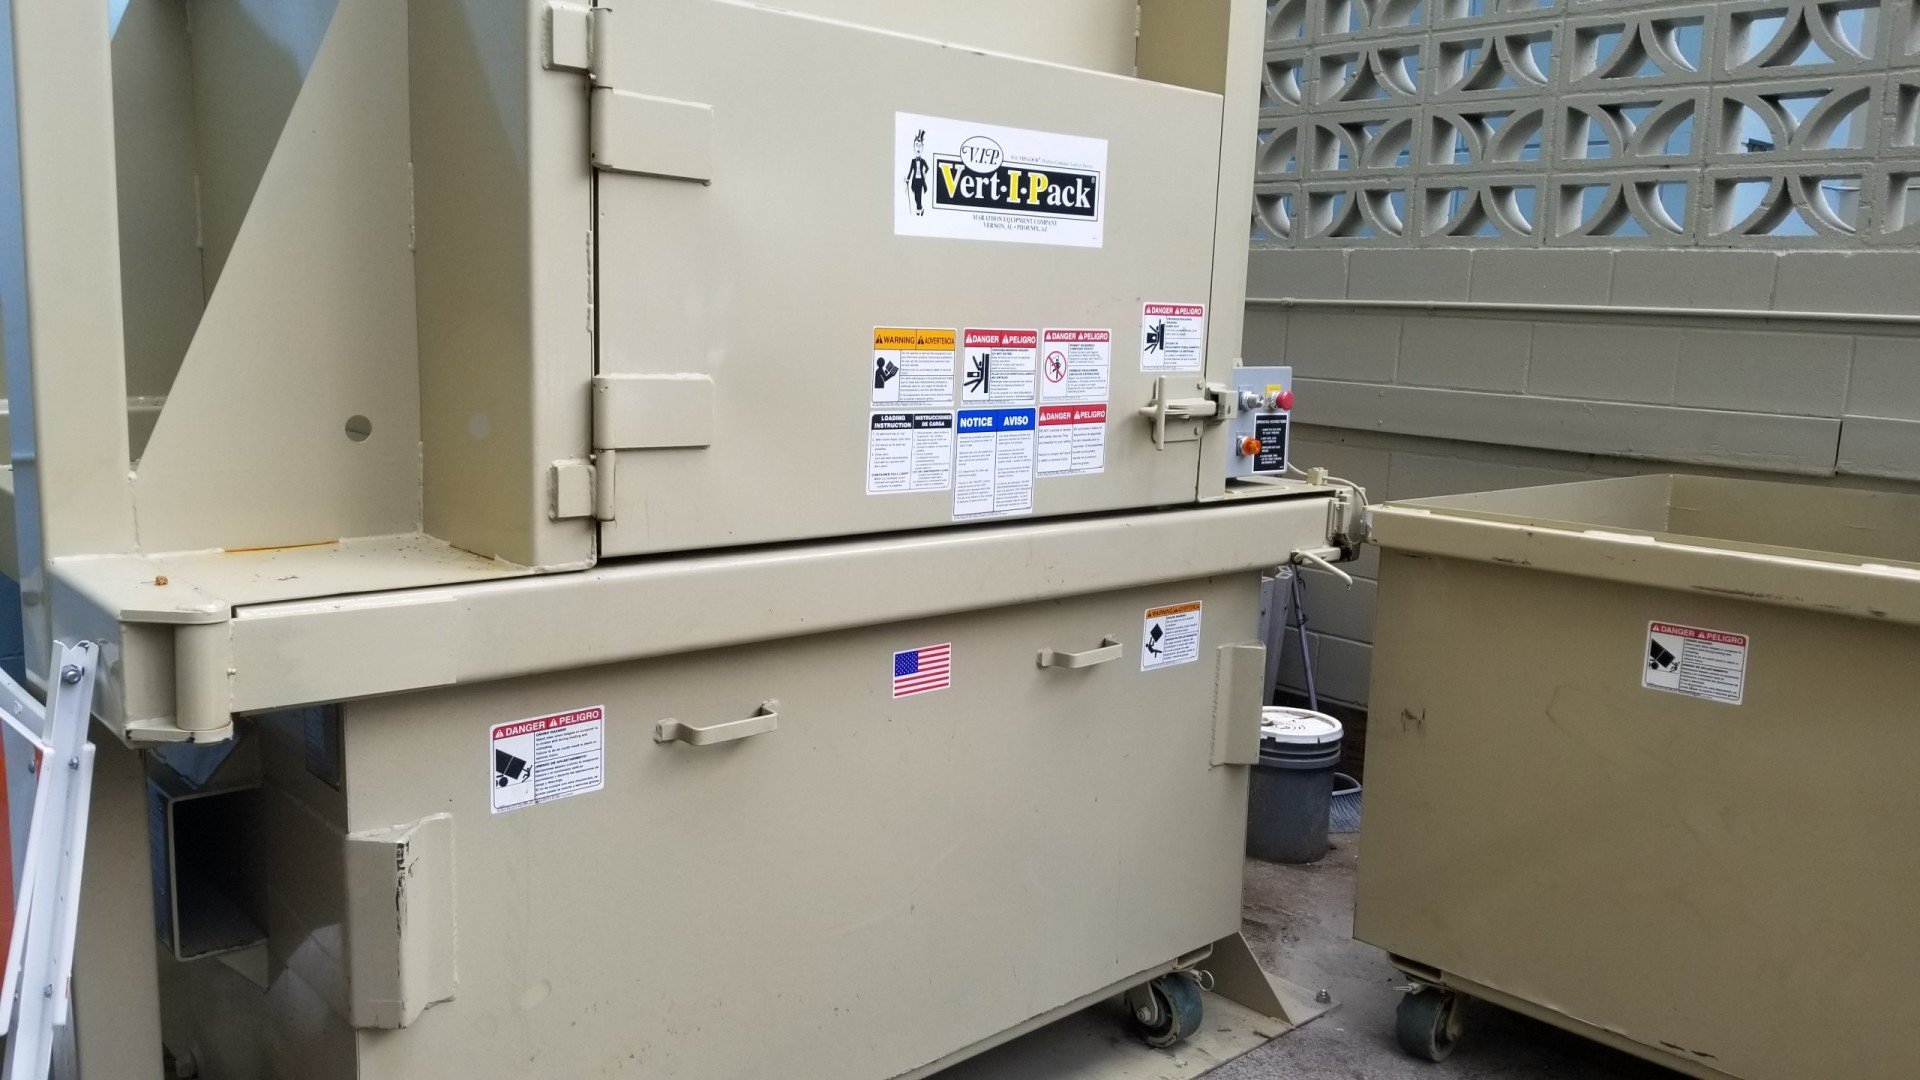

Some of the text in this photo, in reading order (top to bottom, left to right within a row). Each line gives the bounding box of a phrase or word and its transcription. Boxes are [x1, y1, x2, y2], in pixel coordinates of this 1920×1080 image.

[1152, 306, 1202, 315] DANGER PELIGRO
[884, 336, 915, 344] WARNING
[972, 335, 1036, 344] DANGER PELIGRO
[1052, 332, 1076, 340] DANGER
[1046, 410, 1105, 420] DANGER PELIGRO
[960, 417, 993, 428] NOTICE
[1003, 415, 1029, 426] AVISO
[1661, 626, 1744, 645] DANGER PELIGRO
[505, 710, 600, 736] DANGER PELIGRO
